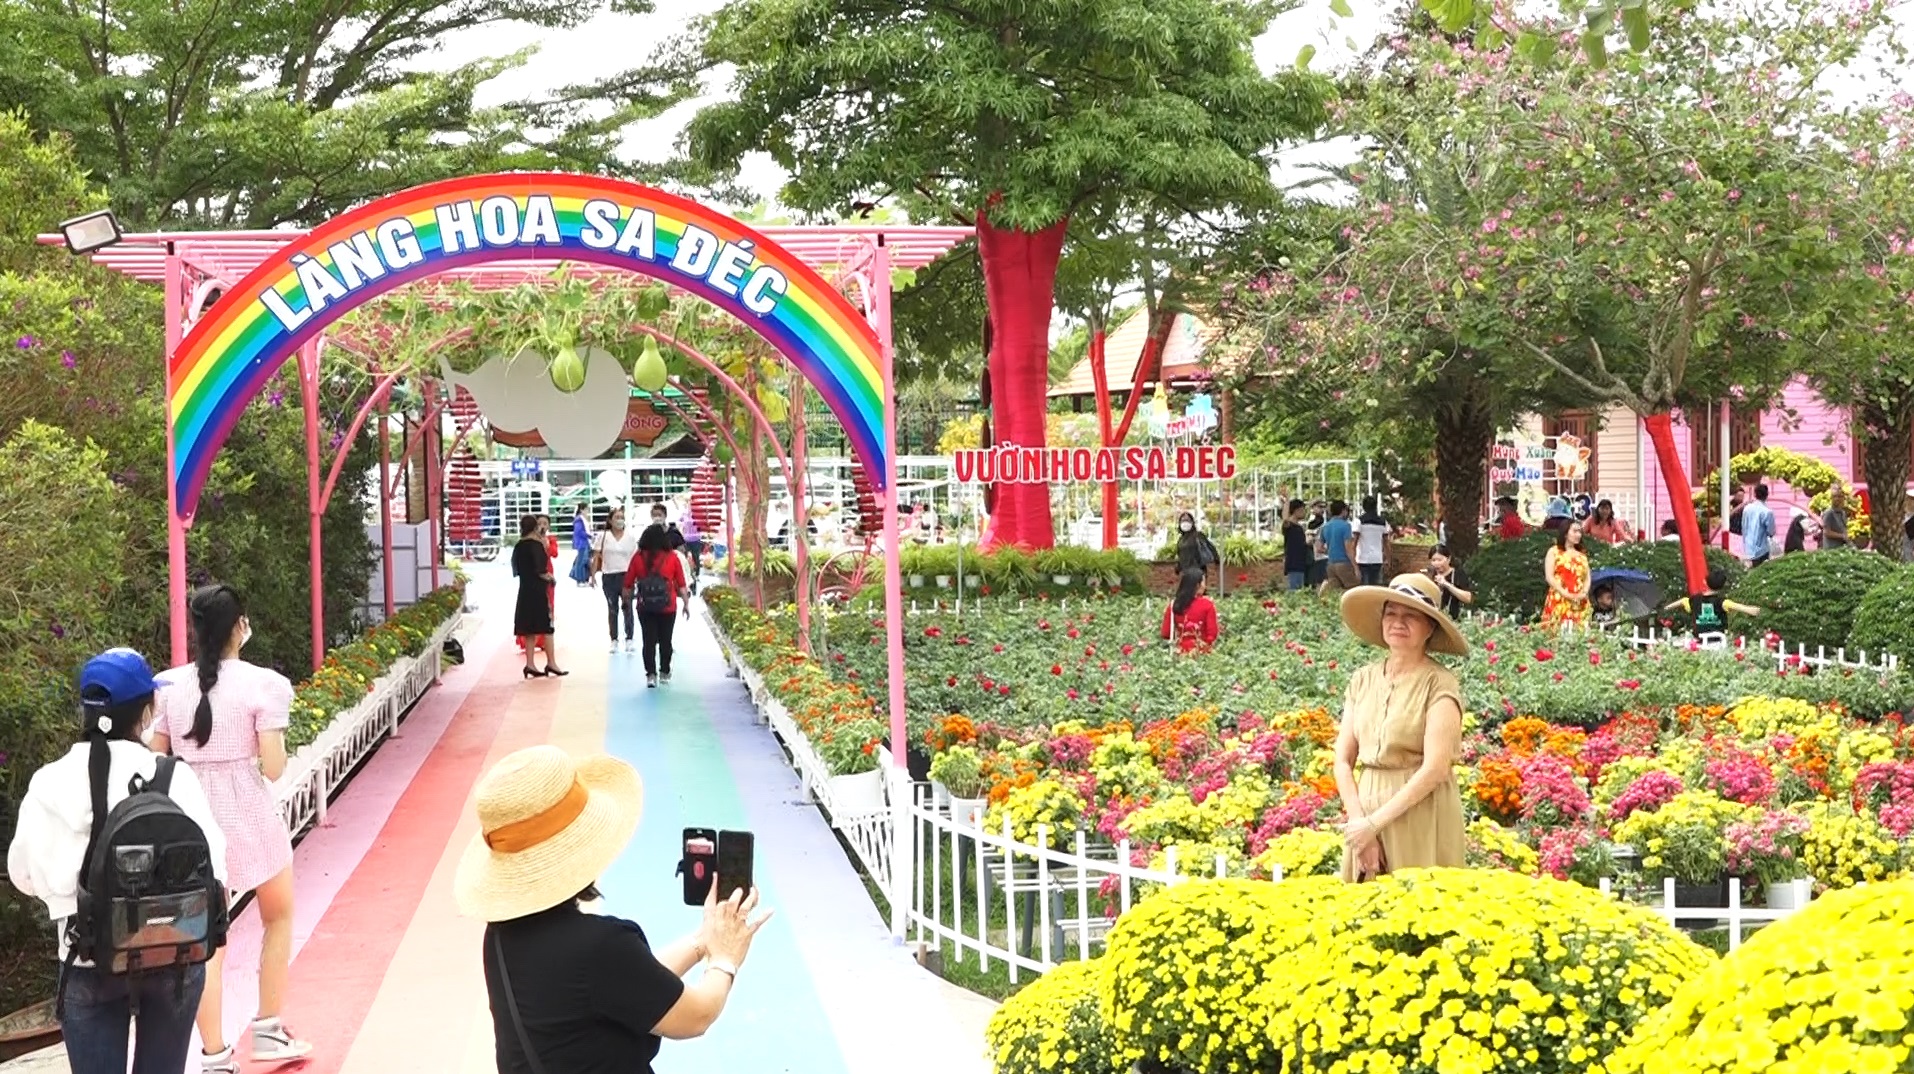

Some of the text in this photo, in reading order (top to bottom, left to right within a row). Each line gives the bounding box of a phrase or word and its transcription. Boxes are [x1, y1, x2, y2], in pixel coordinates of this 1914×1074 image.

[260, 194, 788, 335] LÀNG HOA SA ĐÉC
[1126, 446, 1166, 480] SA
